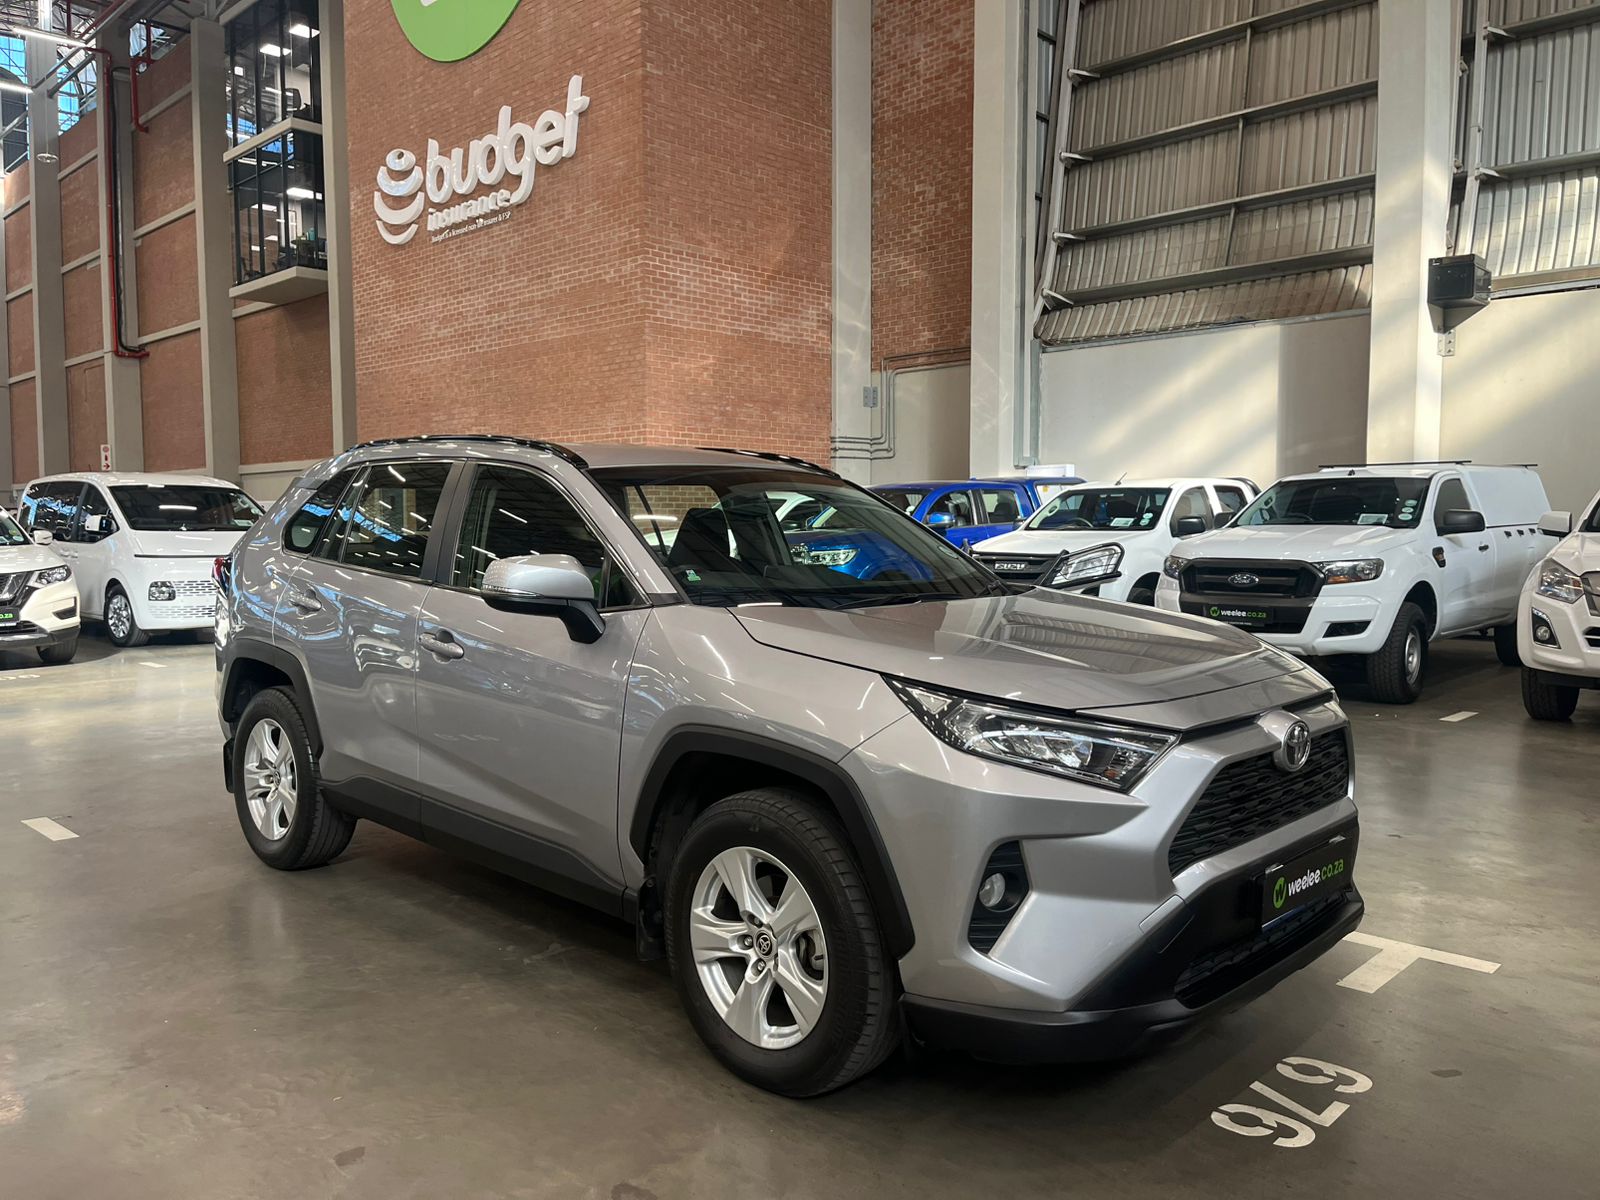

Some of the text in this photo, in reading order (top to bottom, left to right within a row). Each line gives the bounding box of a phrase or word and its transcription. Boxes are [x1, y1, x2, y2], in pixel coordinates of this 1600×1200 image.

[426, 74, 591, 205] budget
[426, 188, 511, 232] insurance
[994, 563, 1026, 571] ISUZU
[1220, 608, 1267, 618] weelee.co.za
[1287, 858, 1345, 897] weelee.co.za
